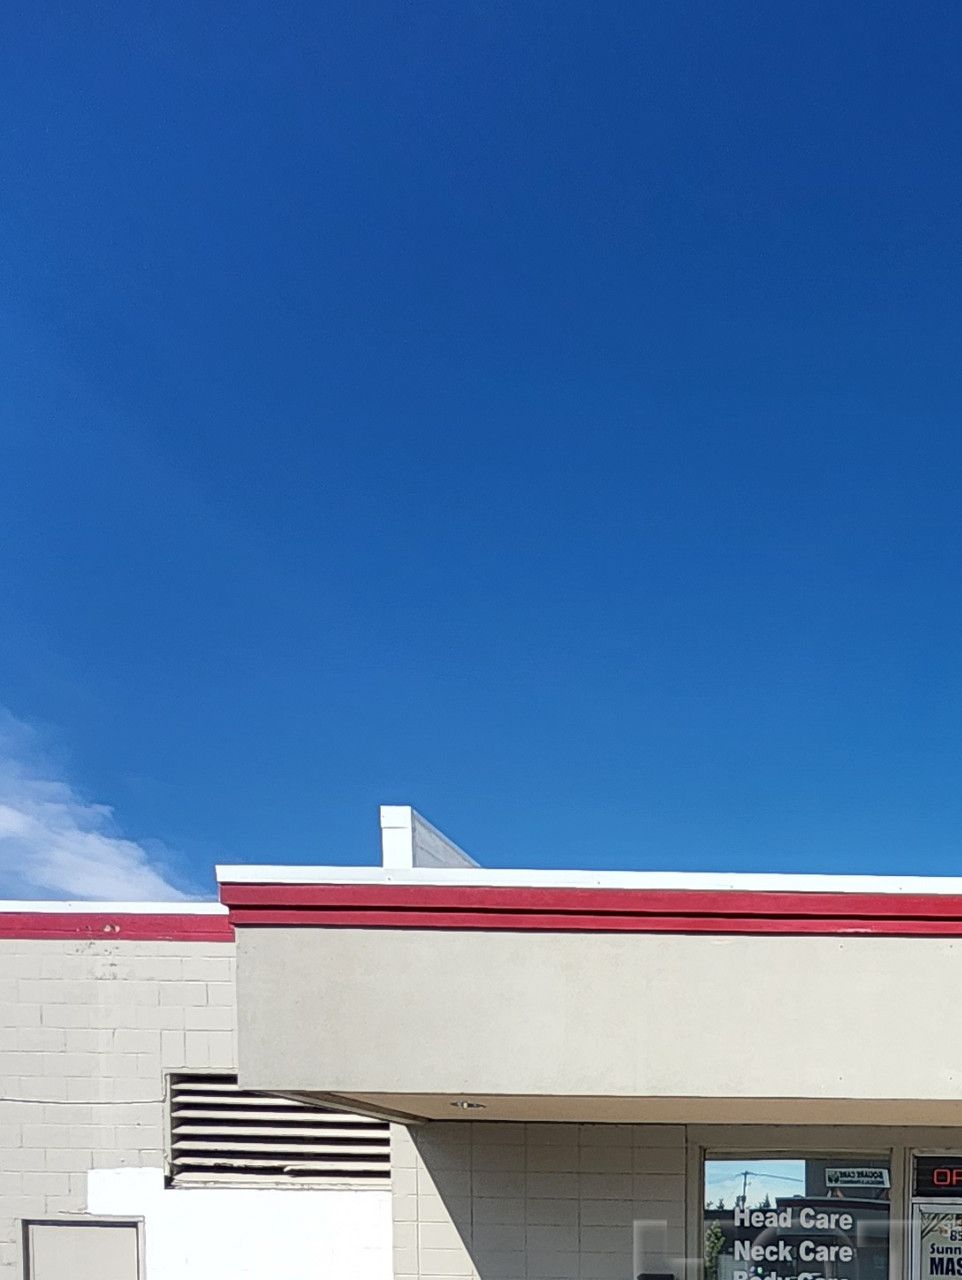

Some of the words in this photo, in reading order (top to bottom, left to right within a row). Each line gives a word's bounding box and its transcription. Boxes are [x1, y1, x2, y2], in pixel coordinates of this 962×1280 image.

[734, 1207, 792, 1228] Head
[799, 1207, 853, 1230] Care
[734, 1240, 793, 1261] Neck
[799, 1240, 853, 1262] Care
